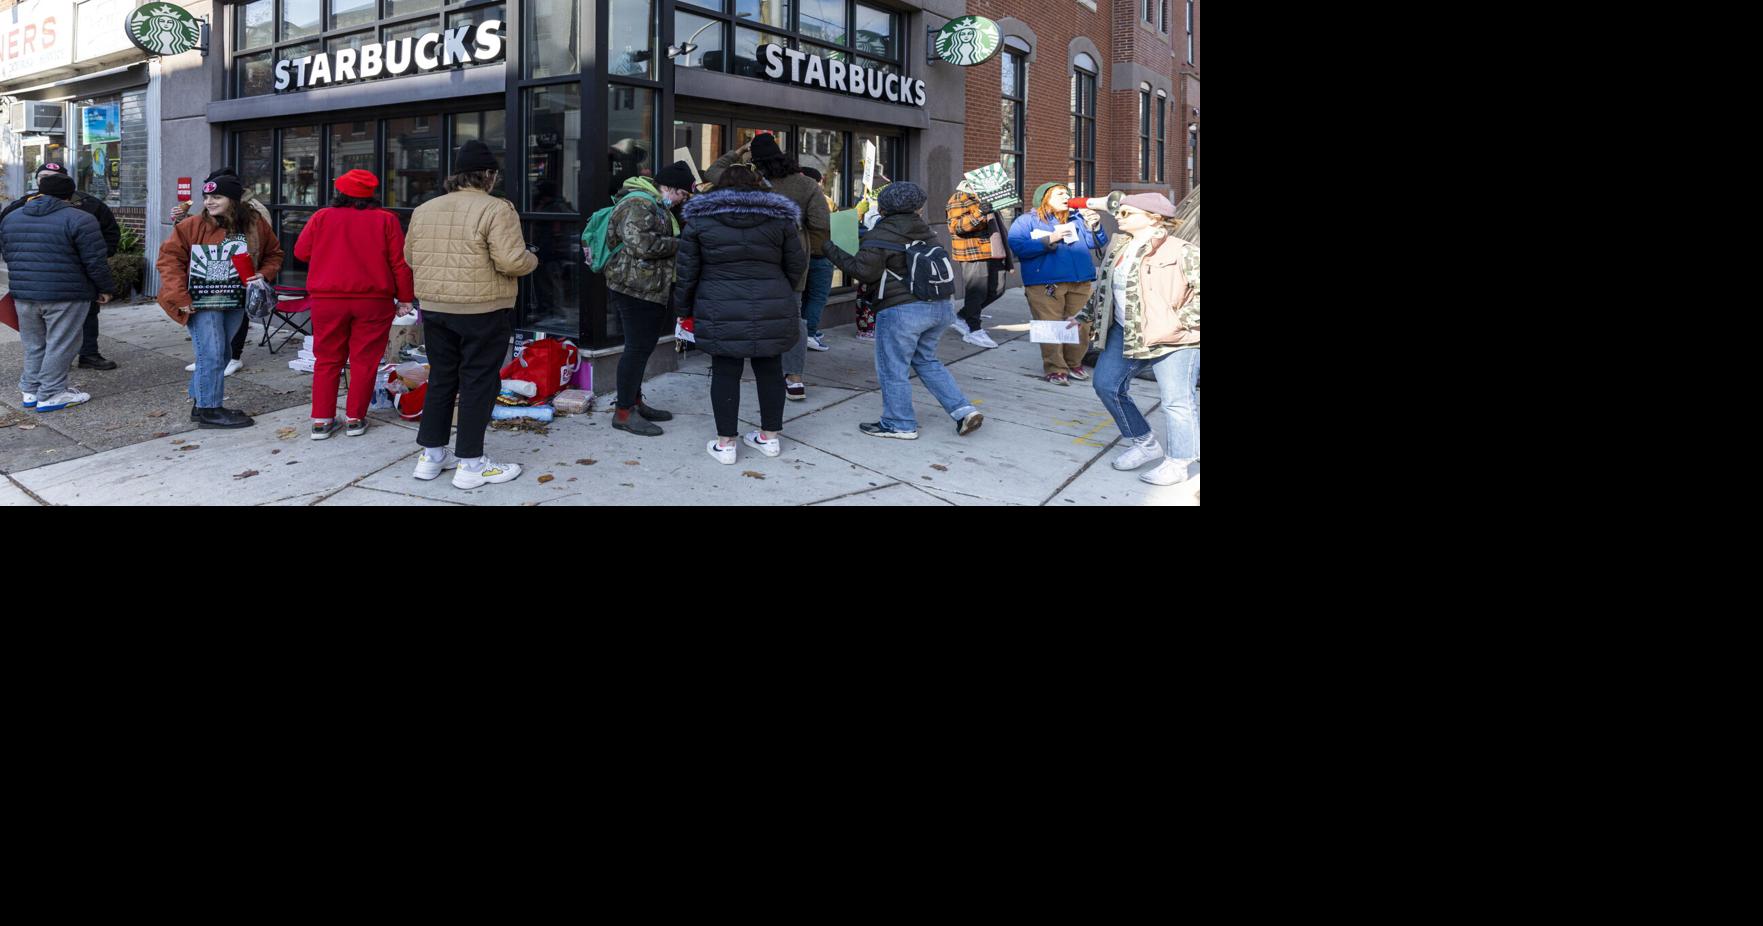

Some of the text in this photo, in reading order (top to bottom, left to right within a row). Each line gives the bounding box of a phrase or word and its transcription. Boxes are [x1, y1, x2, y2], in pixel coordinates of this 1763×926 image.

[0, 16, 56, 62] ERS
[274, 20, 502, 90] STARBUCKS
[765, 44, 927, 106] STARBUCKS
